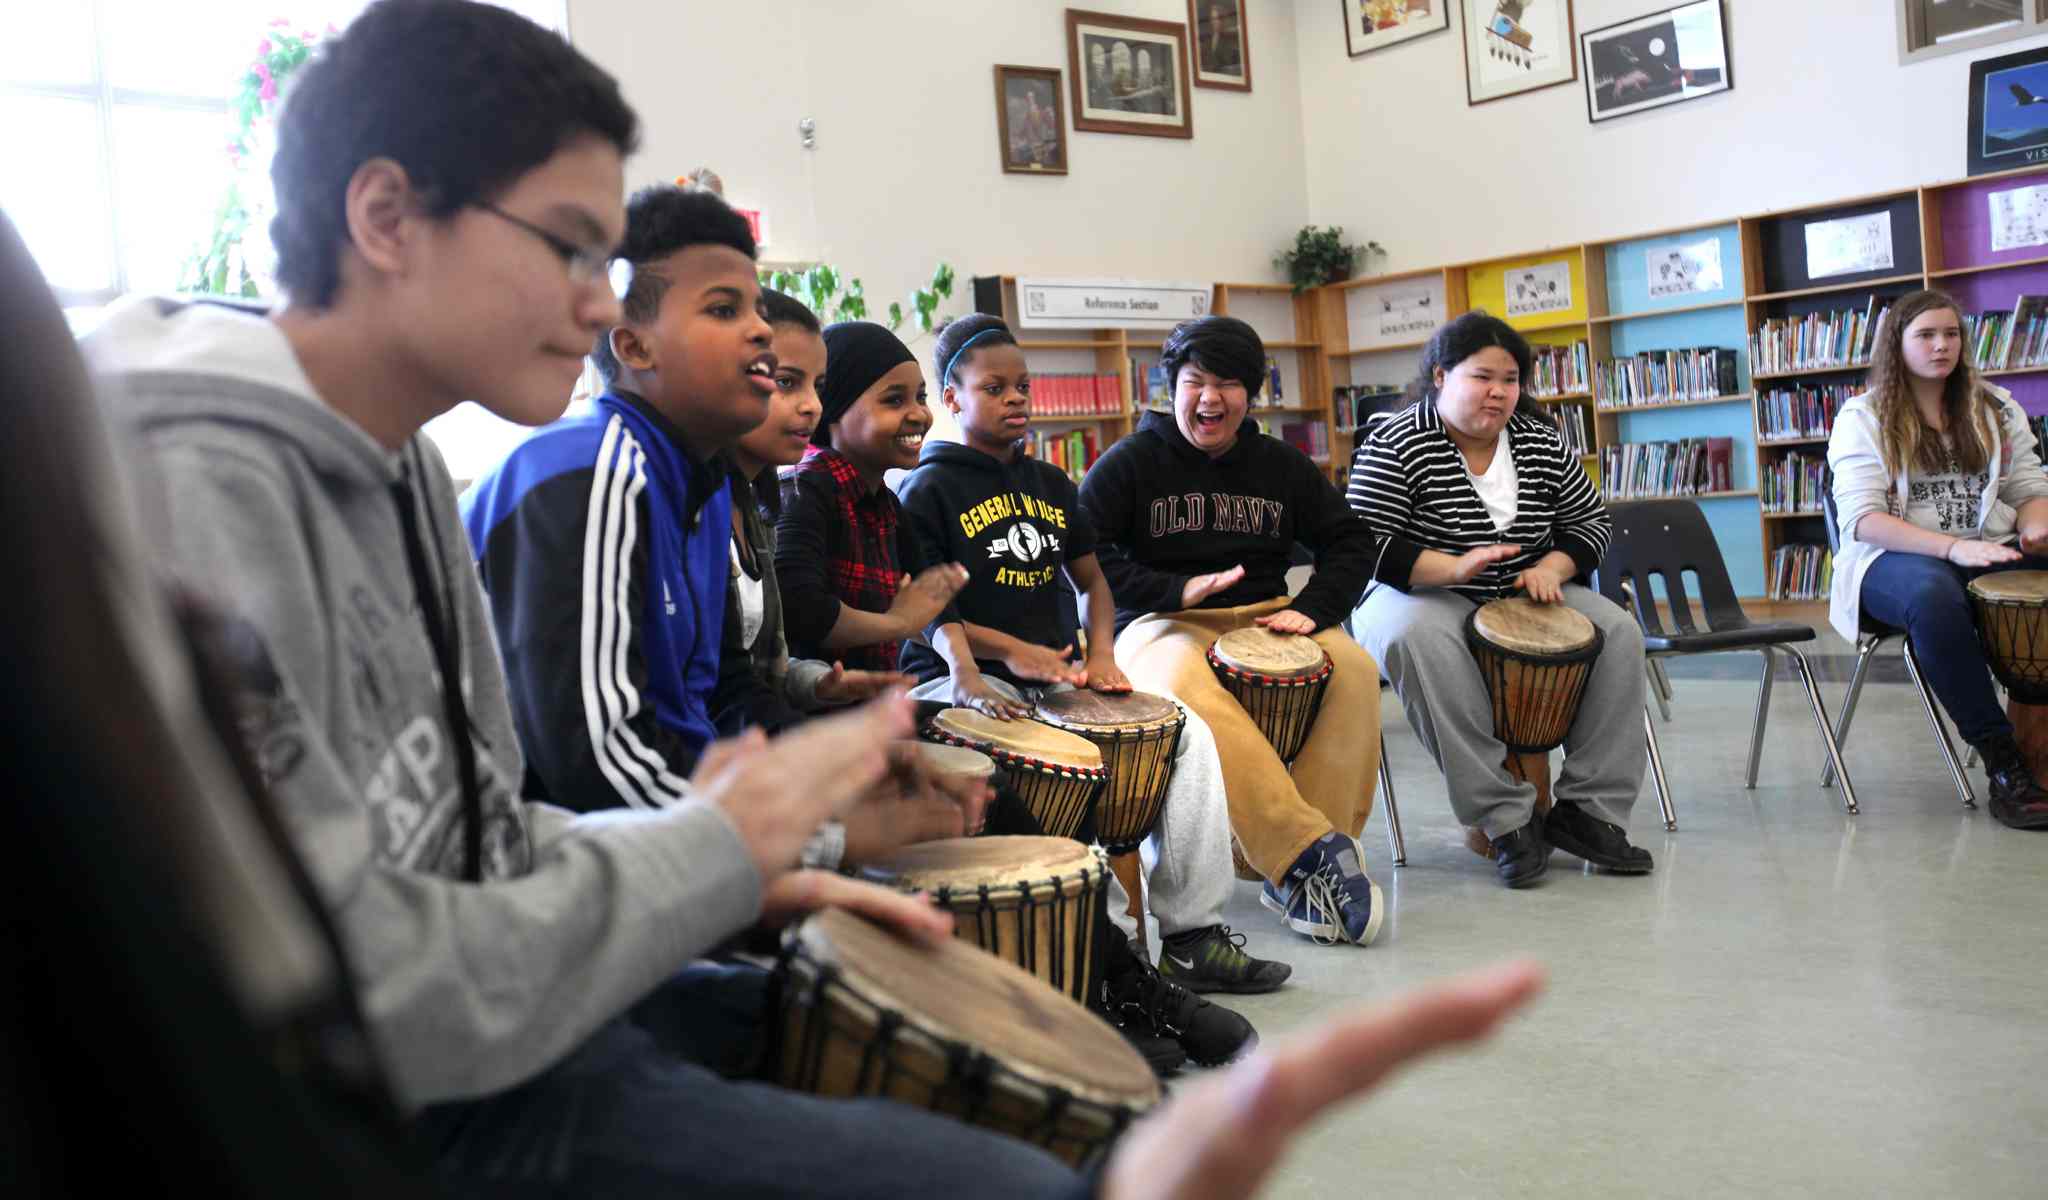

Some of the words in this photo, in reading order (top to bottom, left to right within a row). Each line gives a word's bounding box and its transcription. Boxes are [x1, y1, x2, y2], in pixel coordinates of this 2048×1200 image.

[1084, 297, 1126, 310] Reference
[1129, 299, 1159, 310] Section
[960, 492, 1021, 539] GENERAL
[1151, 493, 1205, 538] OLD
[1211, 493, 1283, 538] NAVY
[995, 566, 1054, 587] ATHLETIC
